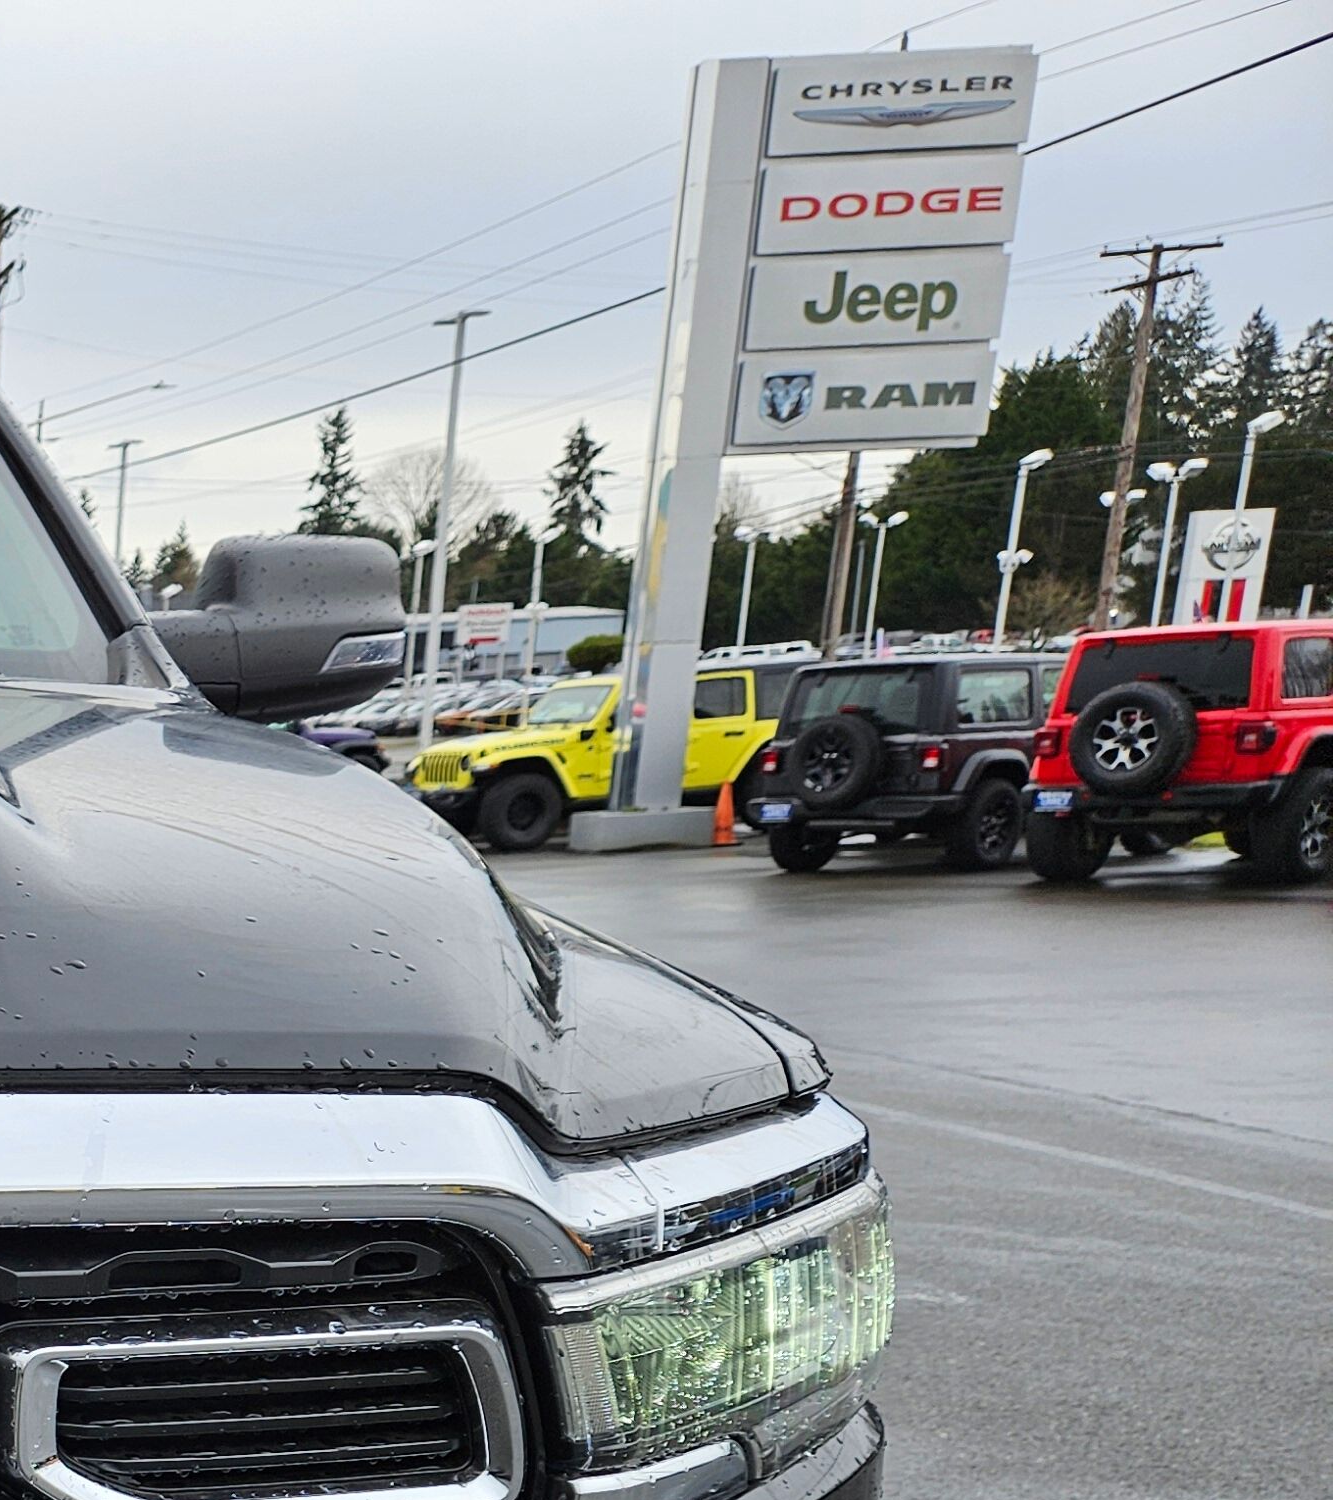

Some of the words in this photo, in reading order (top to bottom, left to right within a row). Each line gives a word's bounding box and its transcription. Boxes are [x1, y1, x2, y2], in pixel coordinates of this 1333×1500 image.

[802, 76, 1014, 100] CHRYSLER
[780, 186, 1004, 222] DODGE
[804, 270, 958, 332] Jeep
[824, 381, 976, 410] RAM
